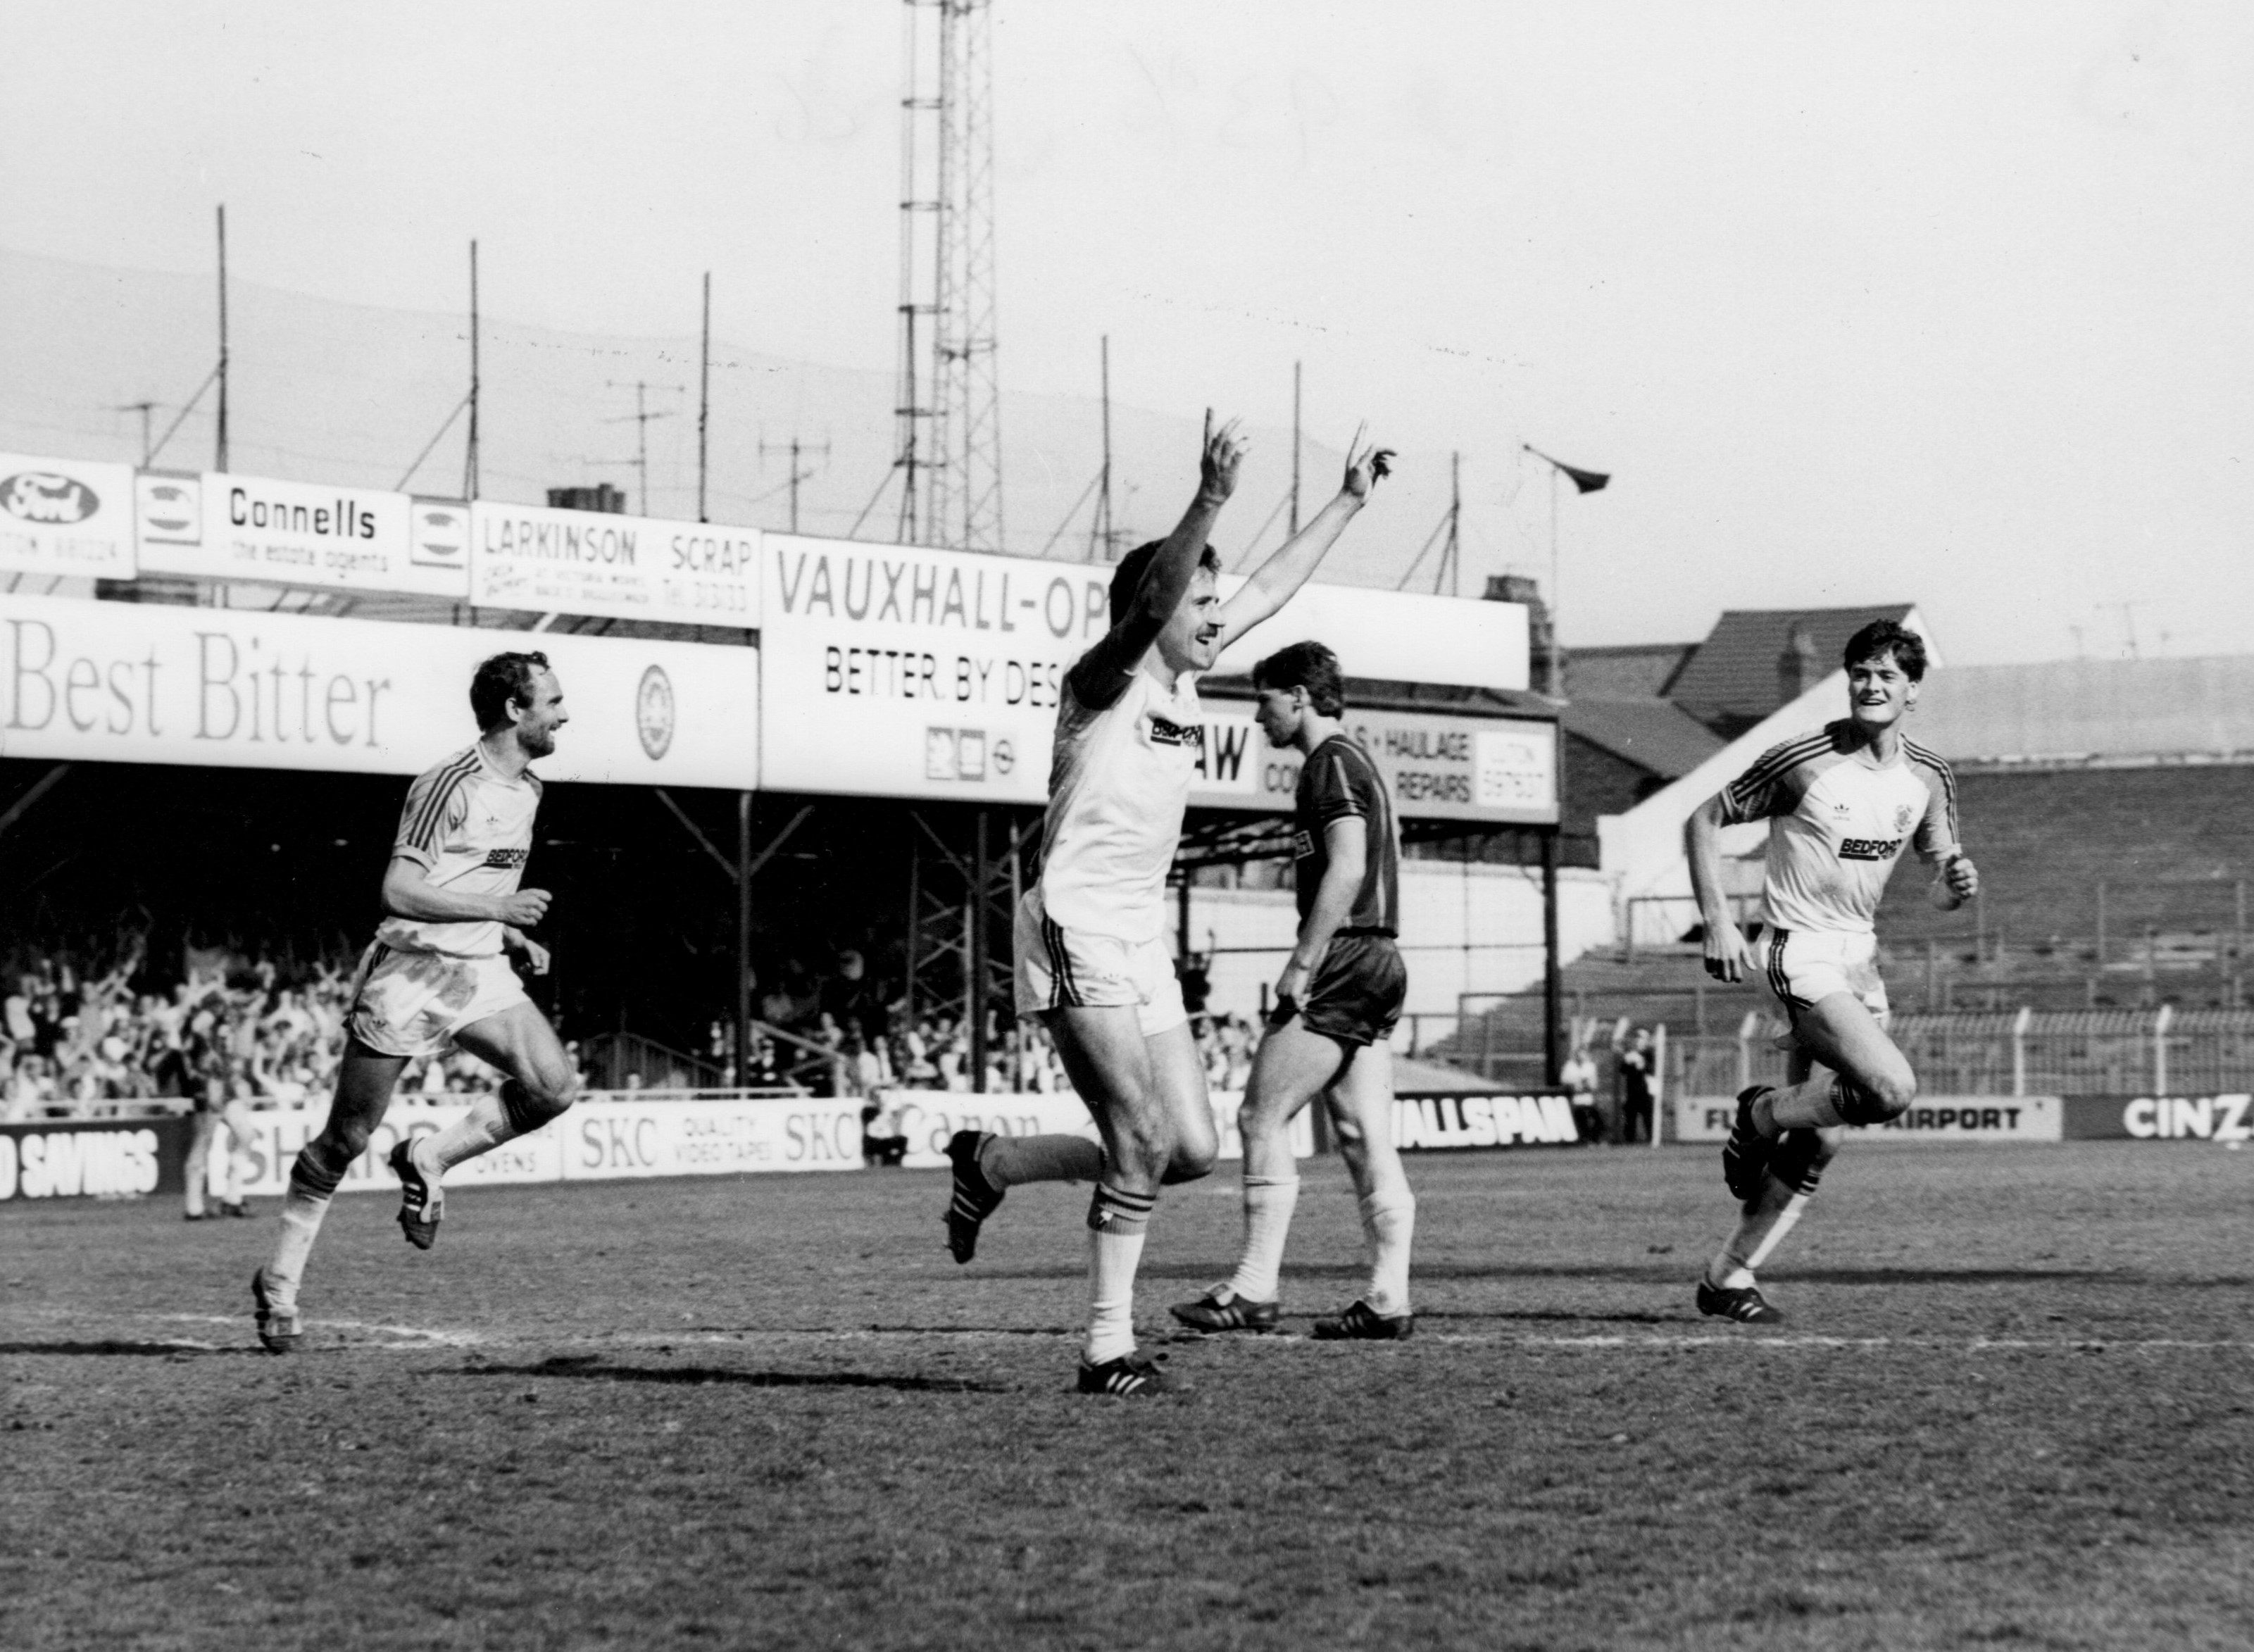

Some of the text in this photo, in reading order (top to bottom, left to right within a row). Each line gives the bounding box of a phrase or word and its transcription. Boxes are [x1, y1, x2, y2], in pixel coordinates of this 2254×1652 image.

[230, 487, 376, 539] Connells
[484, 518, 752, 576] LARKINSON SCRAP
[4, 618, 392, 749] Best Bitter
[826, 646, 946, 701] BETTER
[957, 656, 994, 701] BY
[1385, 727, 1470, 762] HAULAGE
[1396, 770, 1470, 803] REPAIRS
[581, 1117, 658, 1169] SKC
[784, 1112, 854, 1162] SKC
[2124, 1094, 2254, 1141] CINZ
[20, 1128, 159, 1199] SAVINGS
